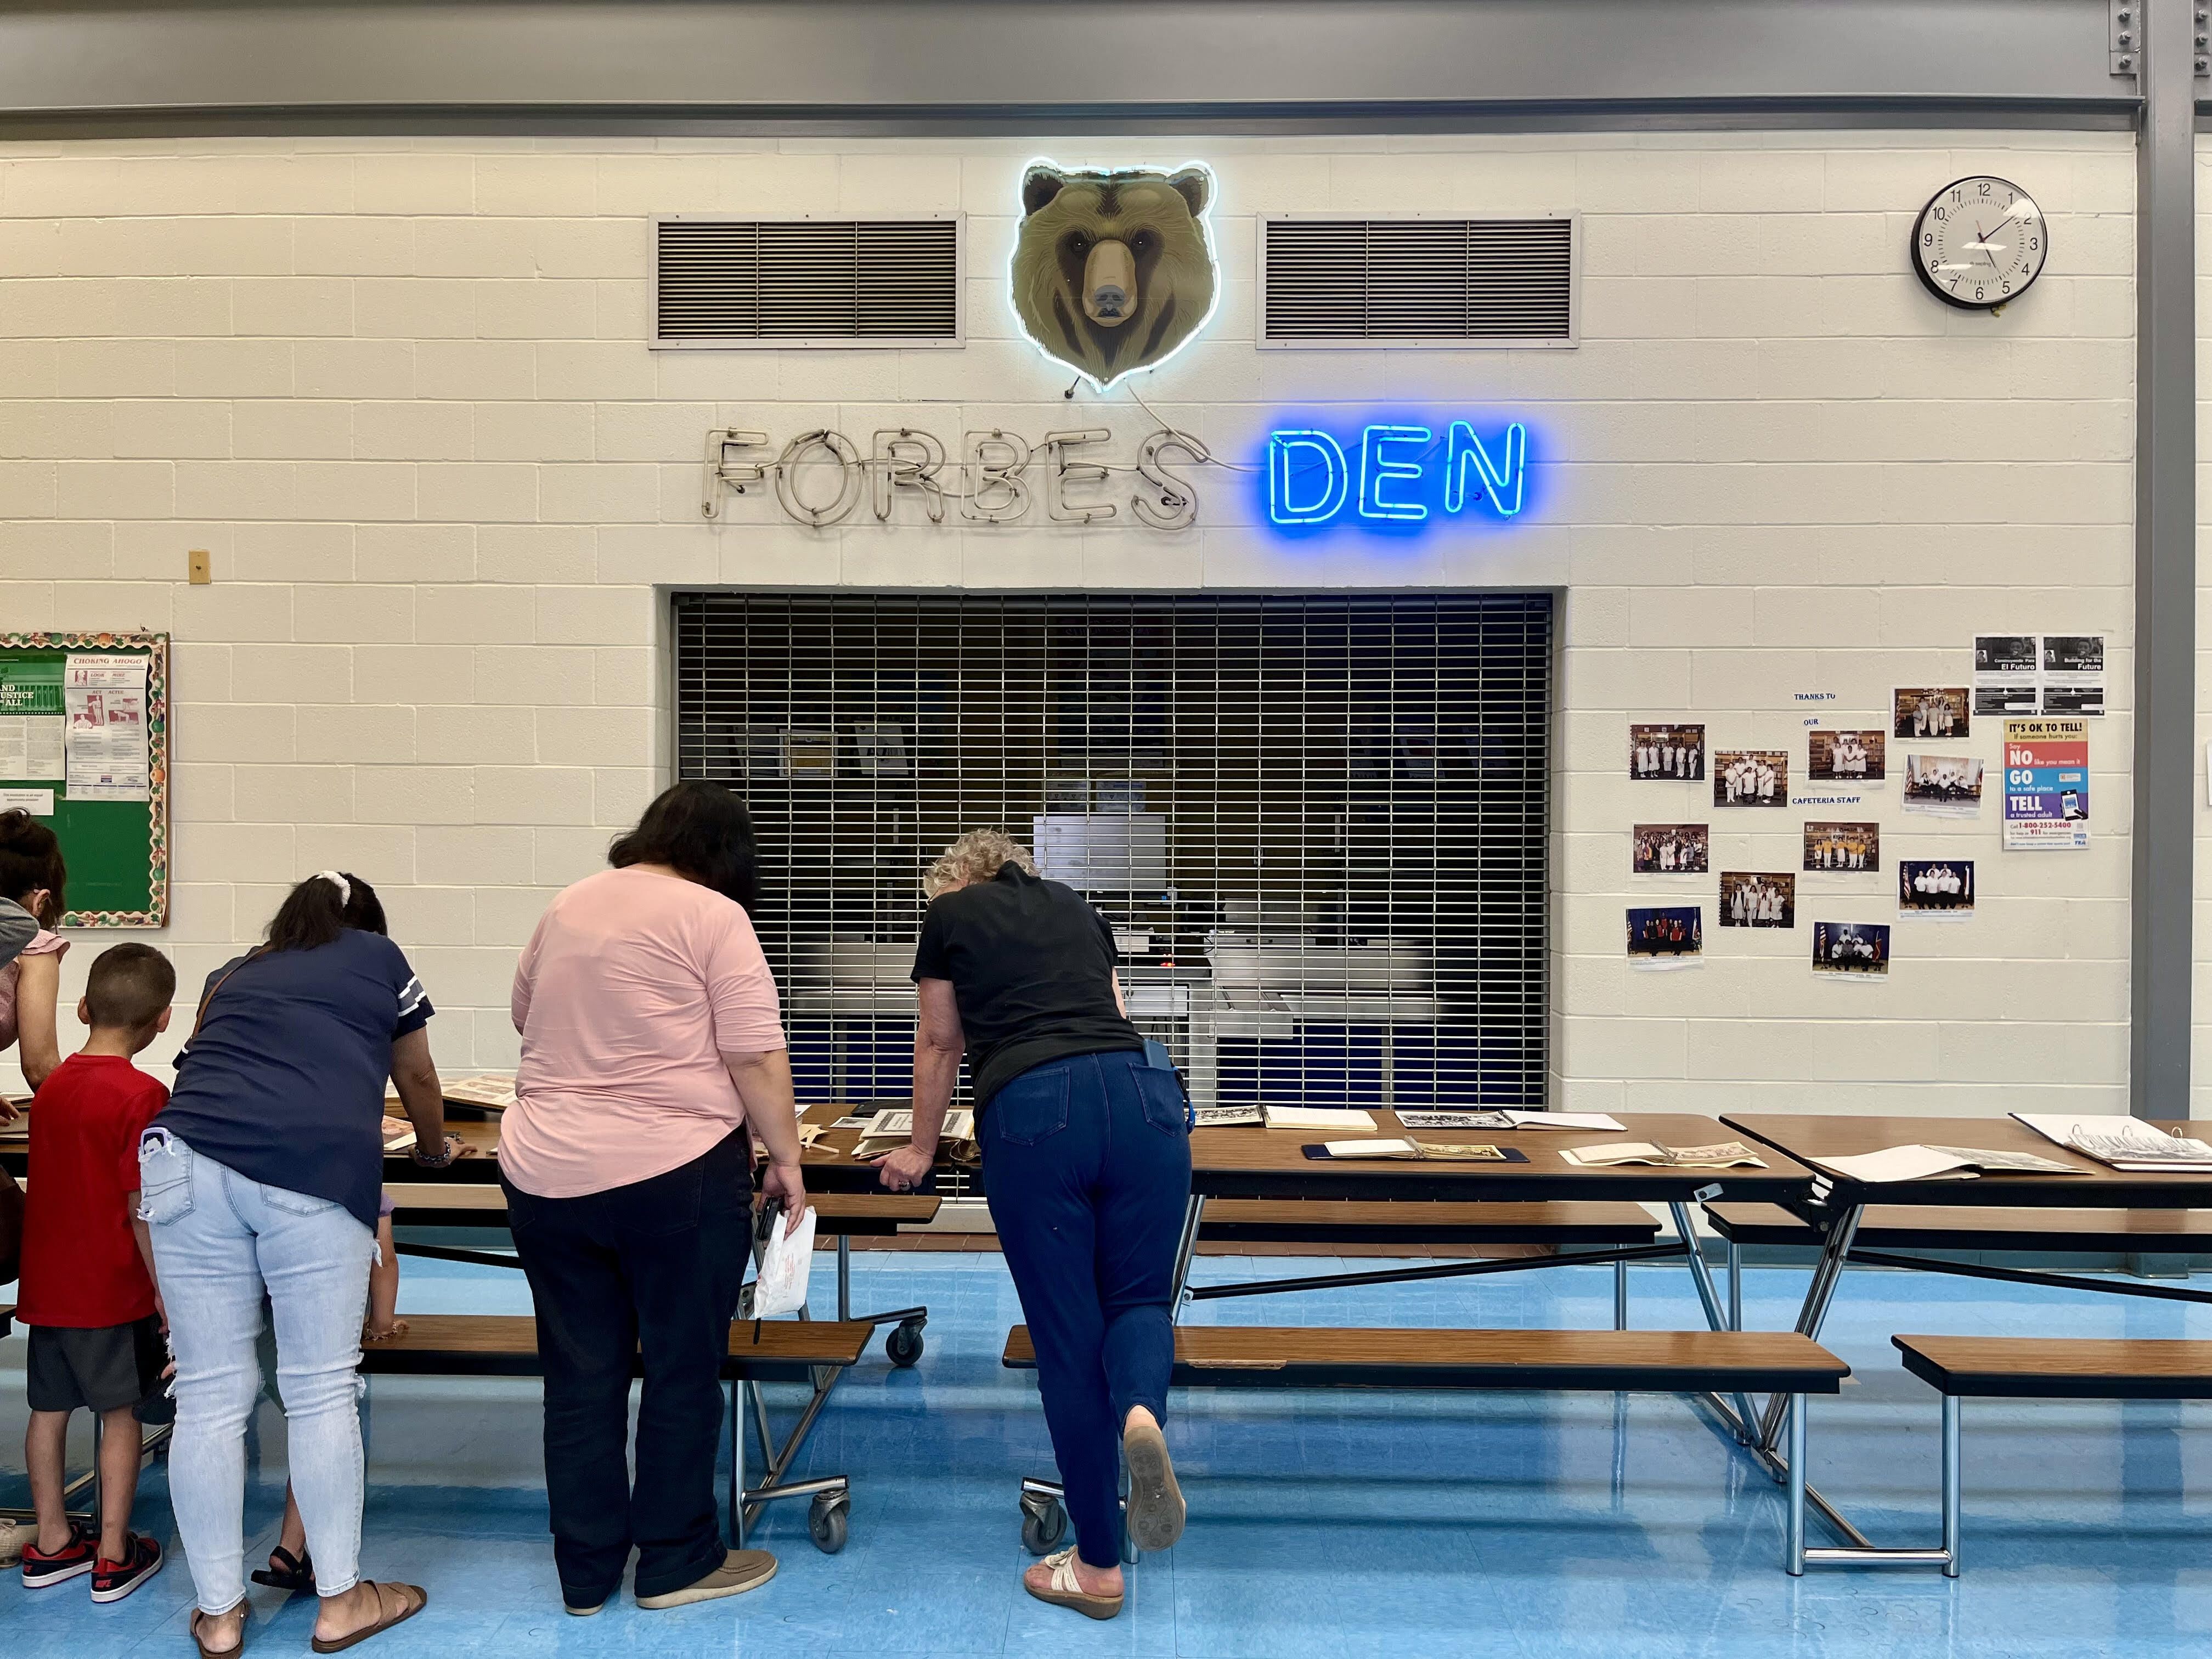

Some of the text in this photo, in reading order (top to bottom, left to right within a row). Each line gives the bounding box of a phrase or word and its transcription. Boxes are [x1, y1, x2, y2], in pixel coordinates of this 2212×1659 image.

[1950, 189, 1962, 202] 11
[1977, 183, 1990, 196] 12
[2008, 192, 2013, 204] 1
[1932, 207, 1945, 220] 10
[2024, 212, 2032, 224] 2
[1924, 233, 1932, 246] 9
[2029, 238, 2038, 250] 3
[1931, 260, 1938, 273] 8
[2021, 263, 2030, 275] 4
[1949, 279, 1958, 291] 7
[2002, 281, 2010, 294] 5
[1976, 287, 1984, 300] 6
[701, 420, 1526, 530] FORBES DEN
[2009, 723, 2083, 732] IT'S OK TO TELL!
[2010, 750, 2033, 765] NO
[2010, 769, 2033, 785] GO
[2010, 795, 2042, 811] TELL
